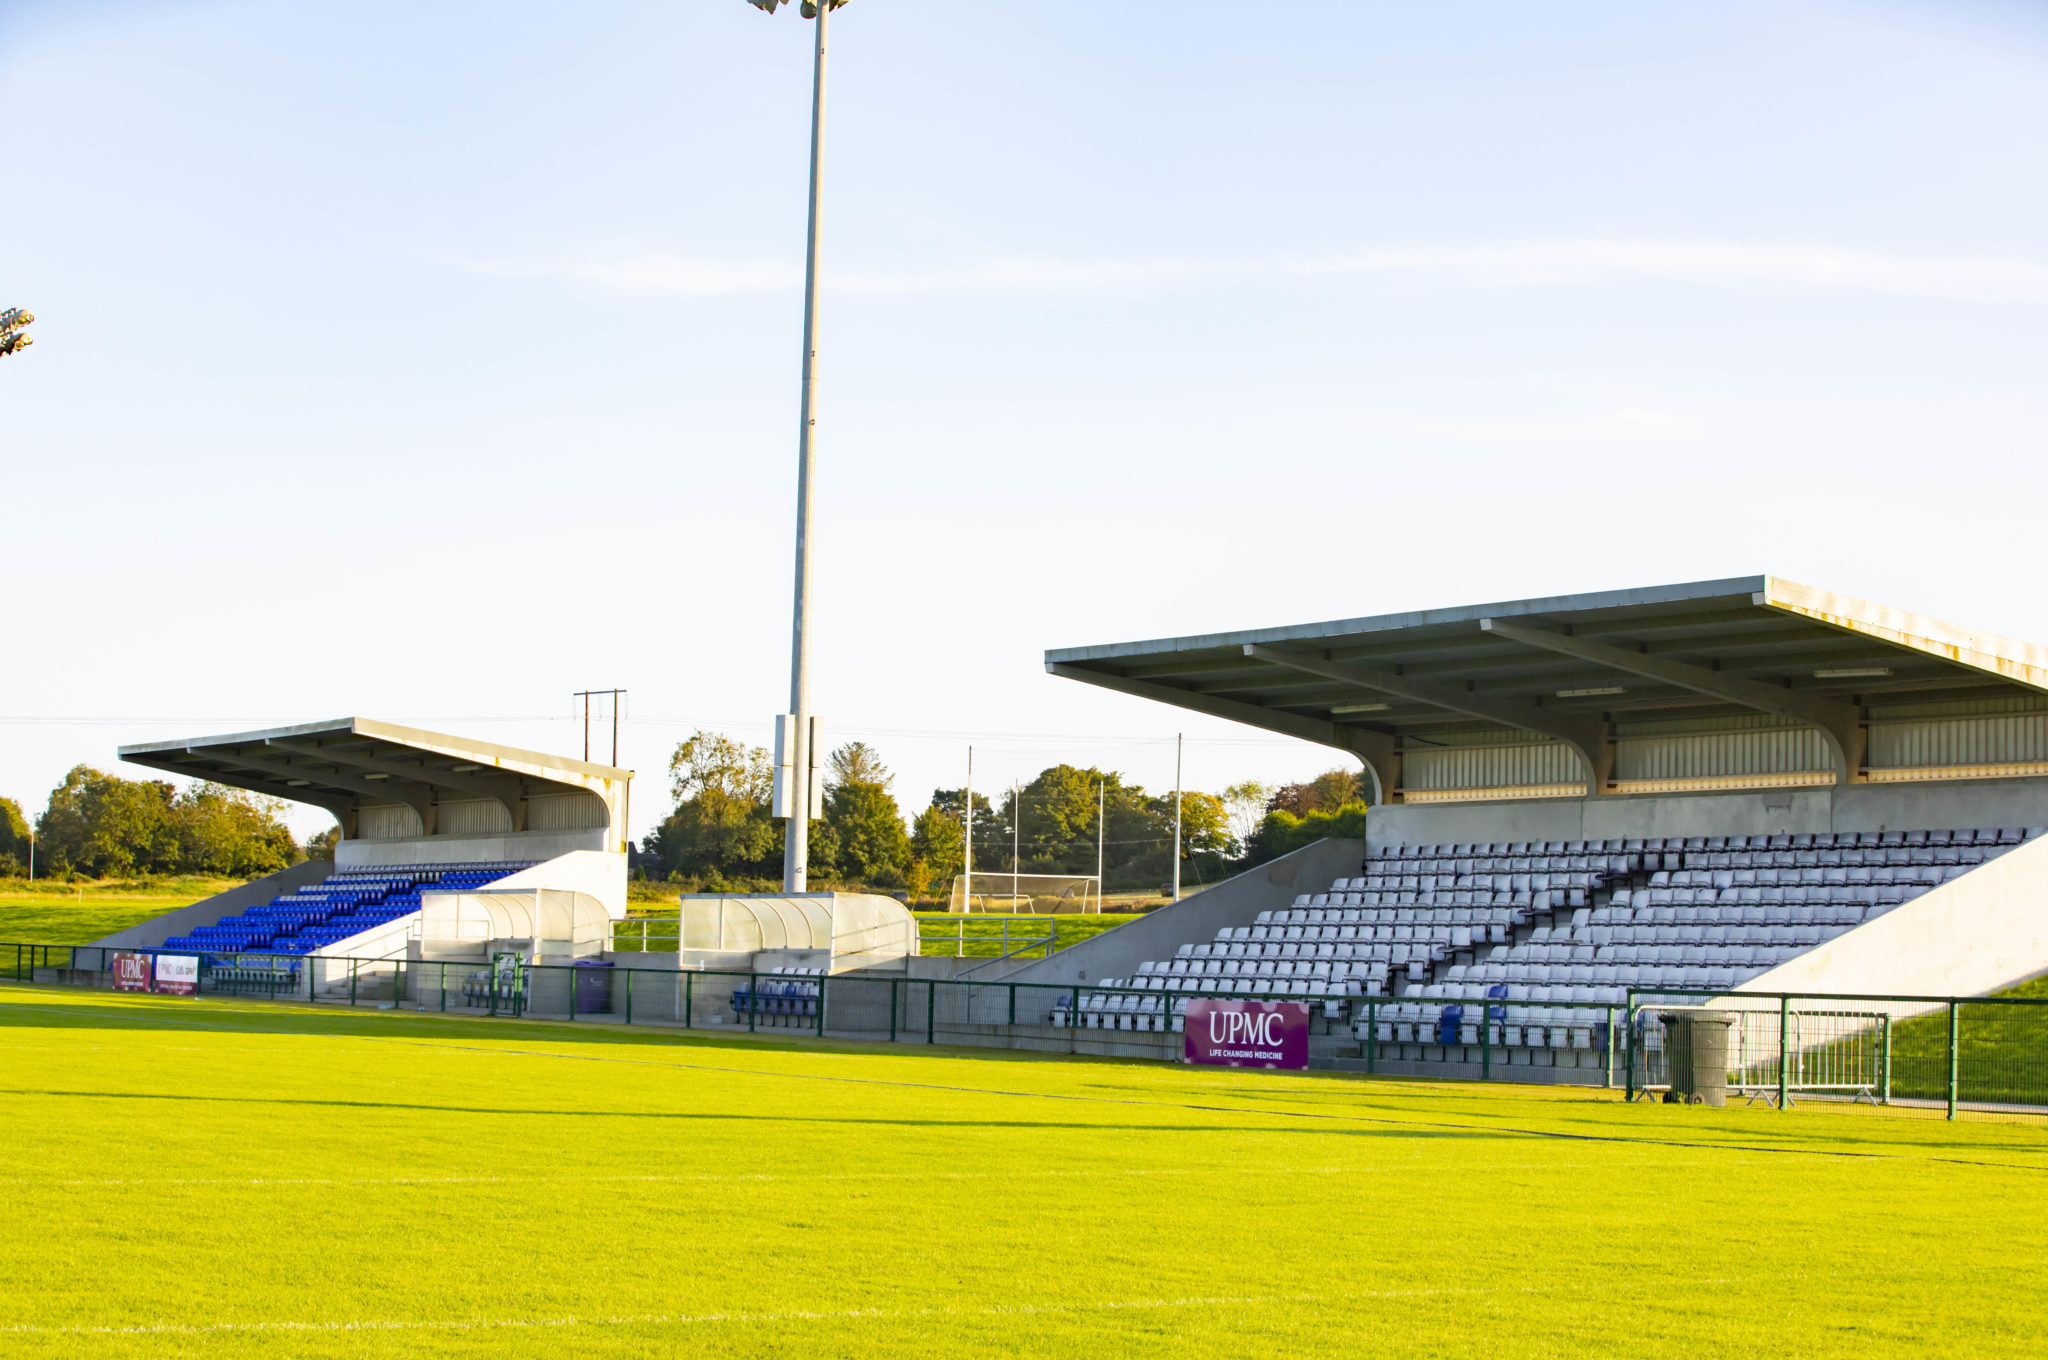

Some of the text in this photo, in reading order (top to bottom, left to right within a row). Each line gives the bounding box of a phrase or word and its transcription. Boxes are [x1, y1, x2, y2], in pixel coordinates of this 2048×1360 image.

[121, 959, 145, 979] UPMC
[1209, 1011, 1284, 1046] UPMC
[1209, 1049, 1283, 1060] LIFE CHANGING MEDICINE
